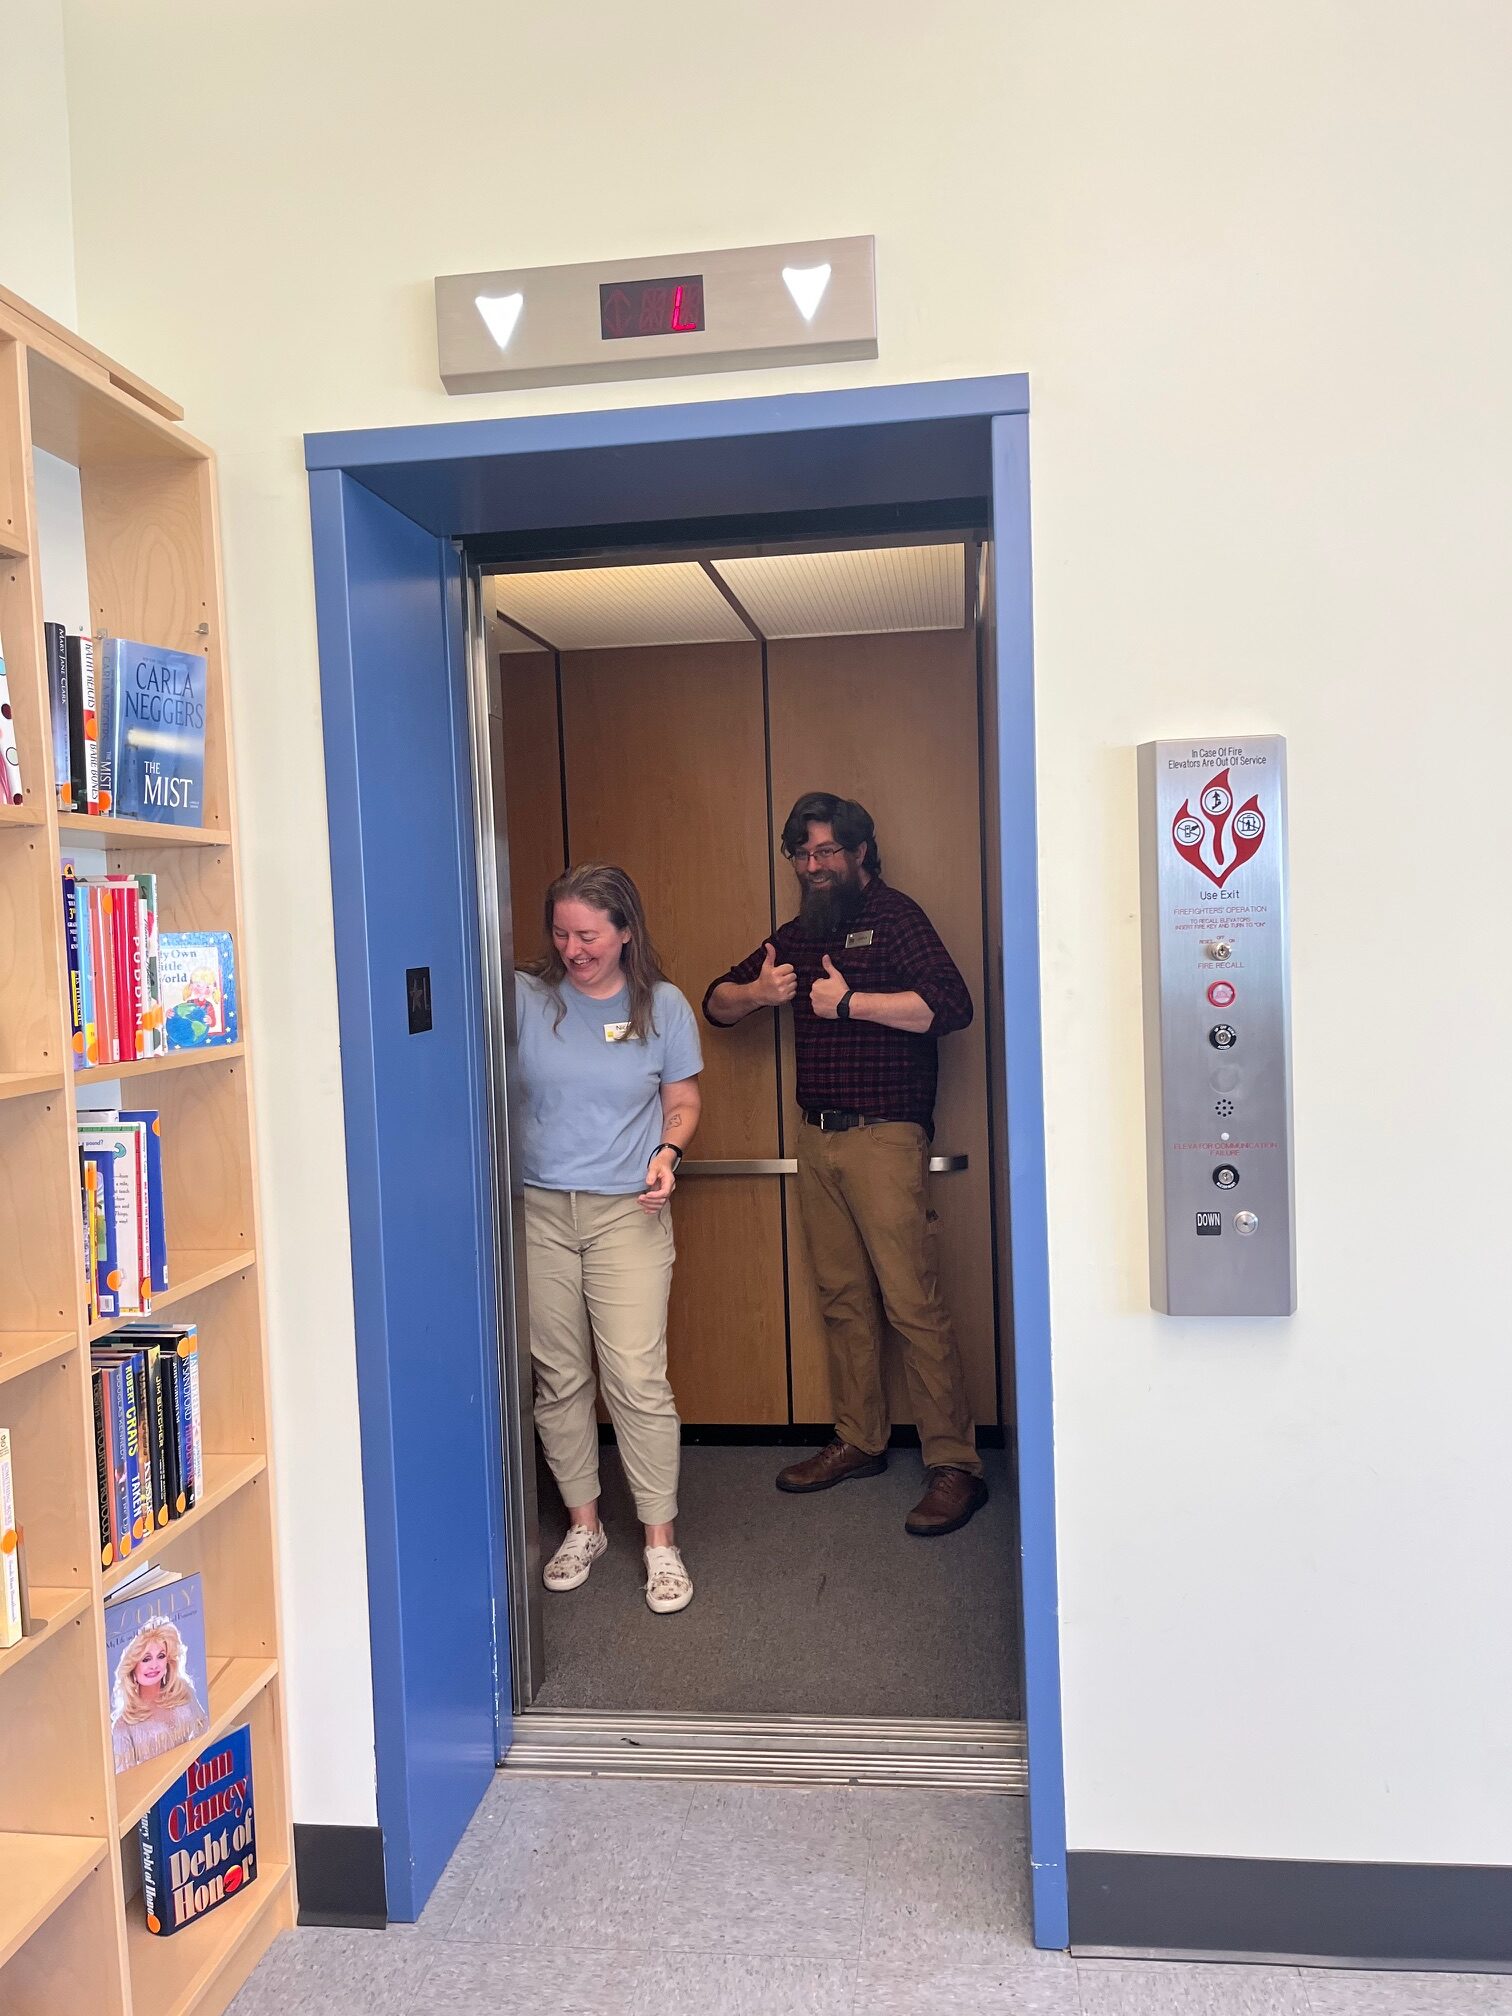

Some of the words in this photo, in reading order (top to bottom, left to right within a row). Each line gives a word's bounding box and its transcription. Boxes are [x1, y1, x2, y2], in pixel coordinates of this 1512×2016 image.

[671, 285, 697, 331] L
[85, 643, 94, 672] KATHY
[86, 676, 96, 708] REICHS
[136, 662, 194, 698] CARLA
[125, 690, 203, 729] NEGGERS
[144, 761, 160, 774] THE
[1168, 760, 1200, 769] Elevators
[1202, 759, 1215, 768] Are
[1216, 758, 1228, 767] Out
[1230, 757, 1239, 766] Of
[1240, 756, 1266, 765] Service
[1192, 750, 1198, 758] In
[1200, 748, 1216, 758] Case
[1218, 747, 1227, 756] Of
[1228, 747, 1242, 756] Fire
[90, 770, 99, 800] BONES
[100, 761, 112, 789] MIST
[144, 774, 193, 808] MIST
[1200, 891, 1217, 900] Use
[1220, 890, 1240, 899] Exit
[171, 949, 197, 959] Own
[1197, 1213, 1220, 1226] DOWN
[190, 1353, 198, 1377] JANE
[125, 1365, 134, 1404] ROBERT
[183, 1368, 191, 1421] SANDFORD
[126, 1406, 138, 1457] CRAIS
[97, 1429, 107, 1478] FOURTH
[132, 1472, 142, 1517] TAKEN
[100, 1481, 111, 1542] PROTOCOL
[186, 1749, 234, 1798] Tom
[168, 1777, 248, 1843] Clancy
[142, 1842, 154, 1872] Debt
[168, 1827, 230, 1892] Debt
[233, 1807, 253, 1851] of
[147, 1871, 156, 1886] of
[147, 1885, 156, 1916] Hono
